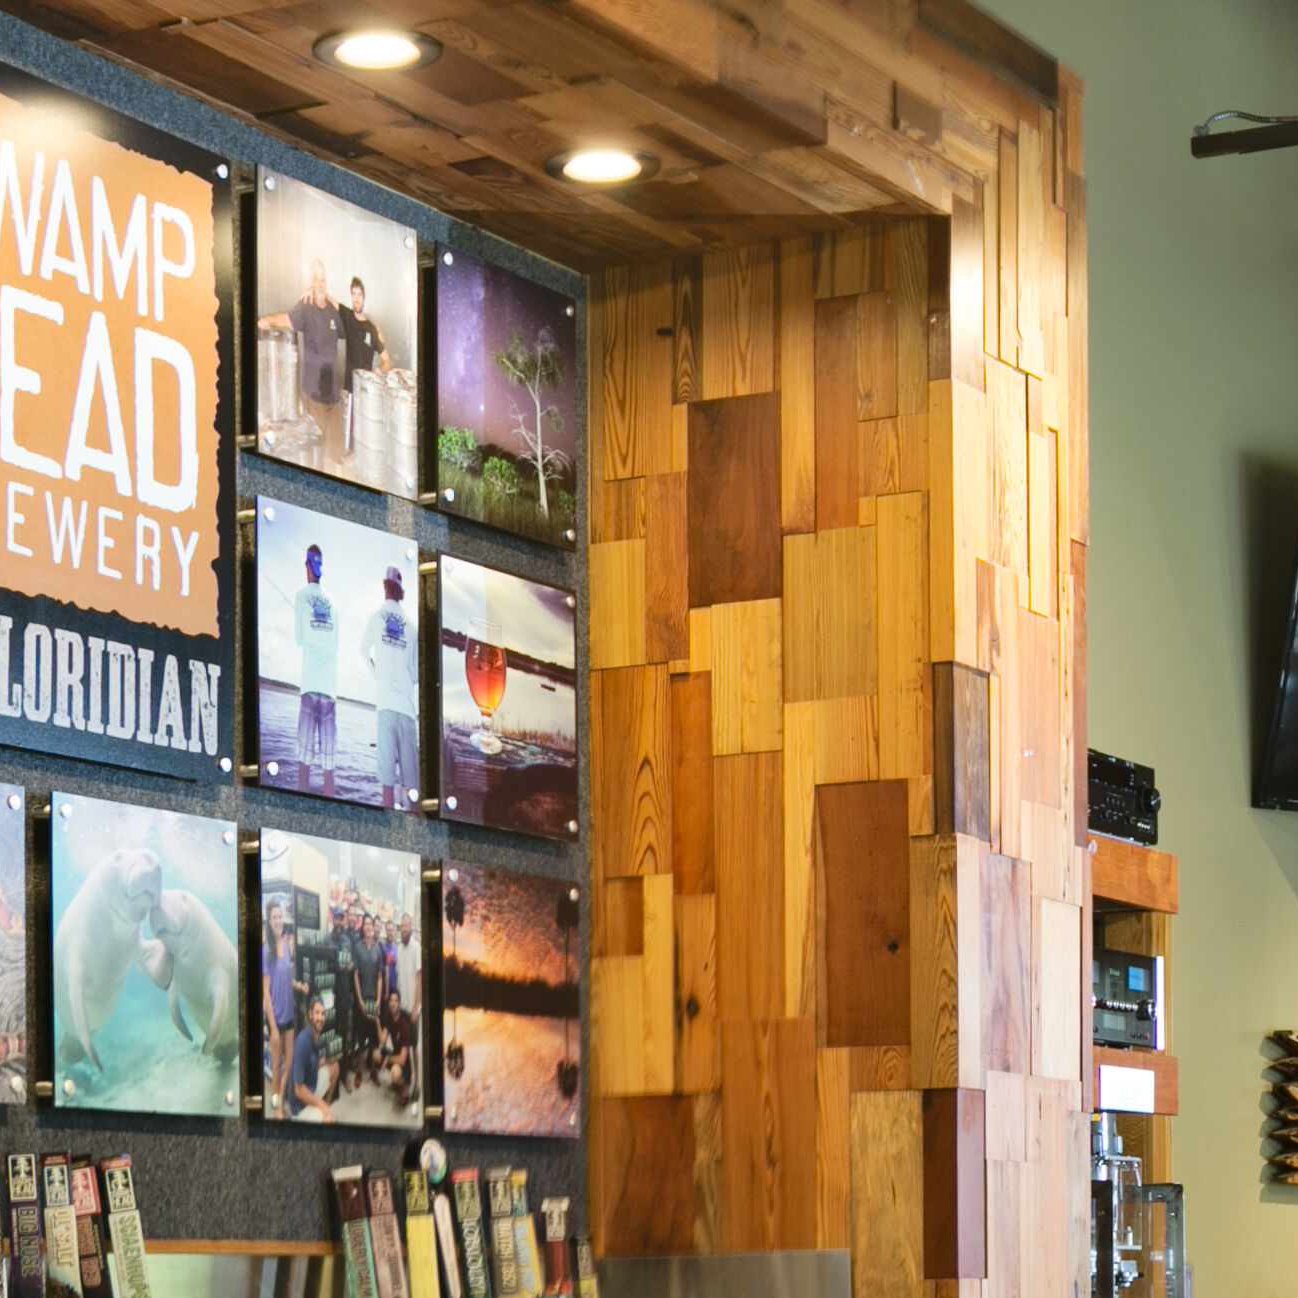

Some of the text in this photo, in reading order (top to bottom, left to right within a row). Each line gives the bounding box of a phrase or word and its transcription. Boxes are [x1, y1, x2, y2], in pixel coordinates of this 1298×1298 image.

[18, 1208, 41, 1278] BIG NOSE
[57, 1232, 75, 1266] SALT
[498, 1223, 513, 1258] BATCH
